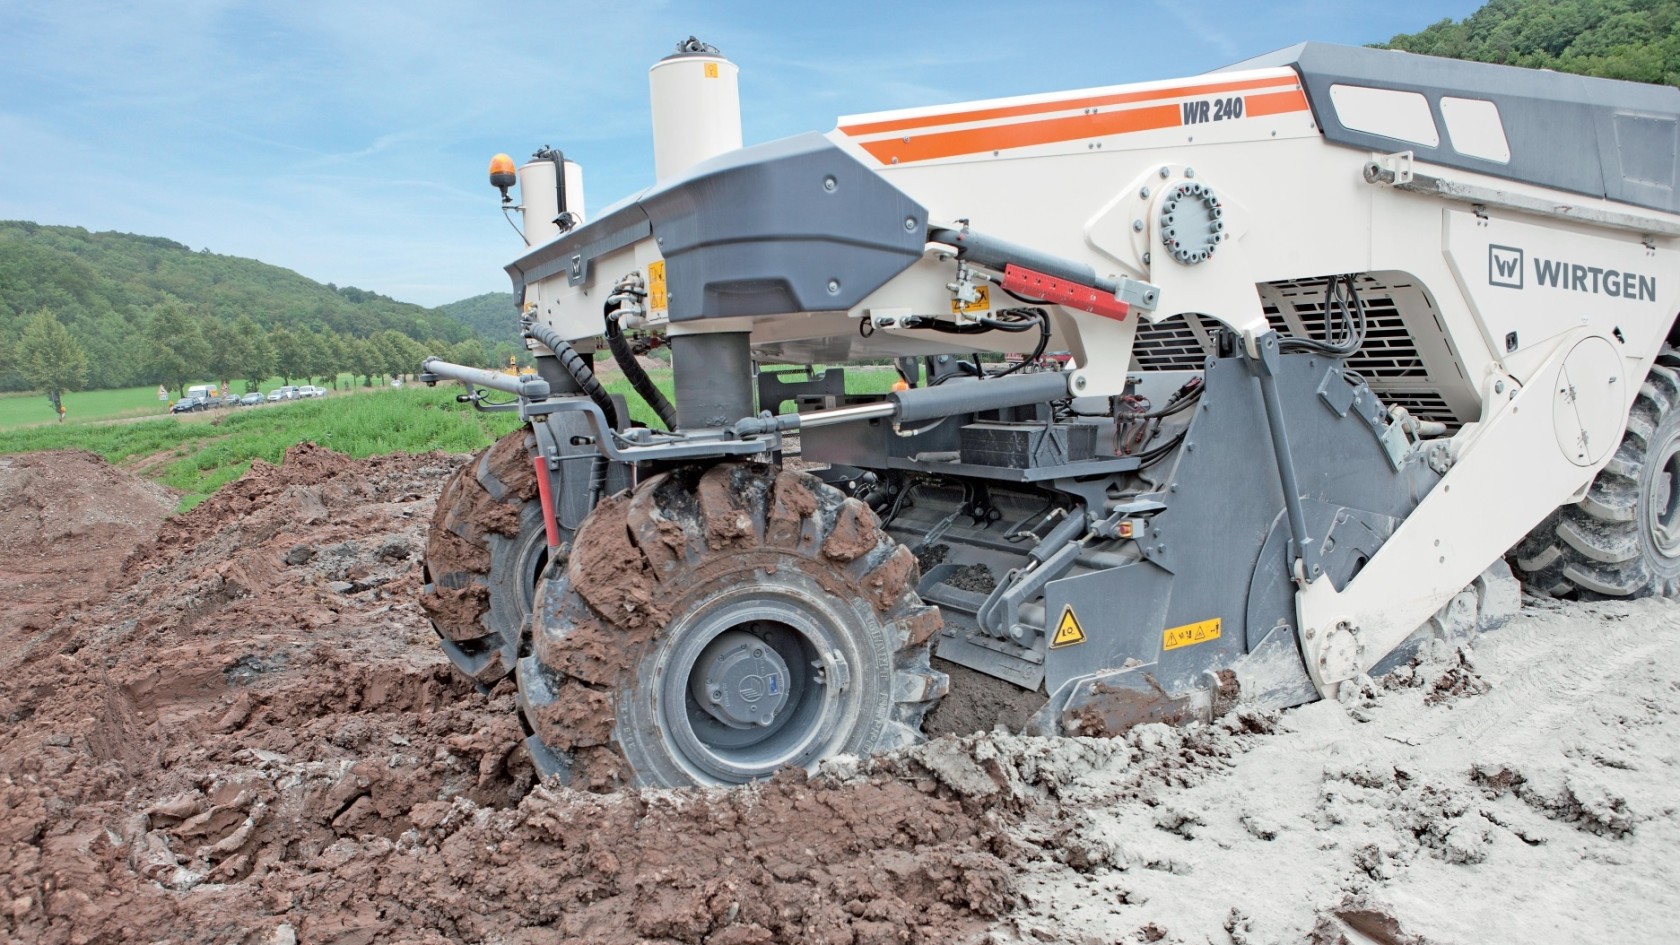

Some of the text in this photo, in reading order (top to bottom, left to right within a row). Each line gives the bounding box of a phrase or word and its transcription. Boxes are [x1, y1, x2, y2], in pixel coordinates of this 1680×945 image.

[1183, 97, 1243, 125] WR 240
[1534, 258, 1656, 302] WIRTGEN
